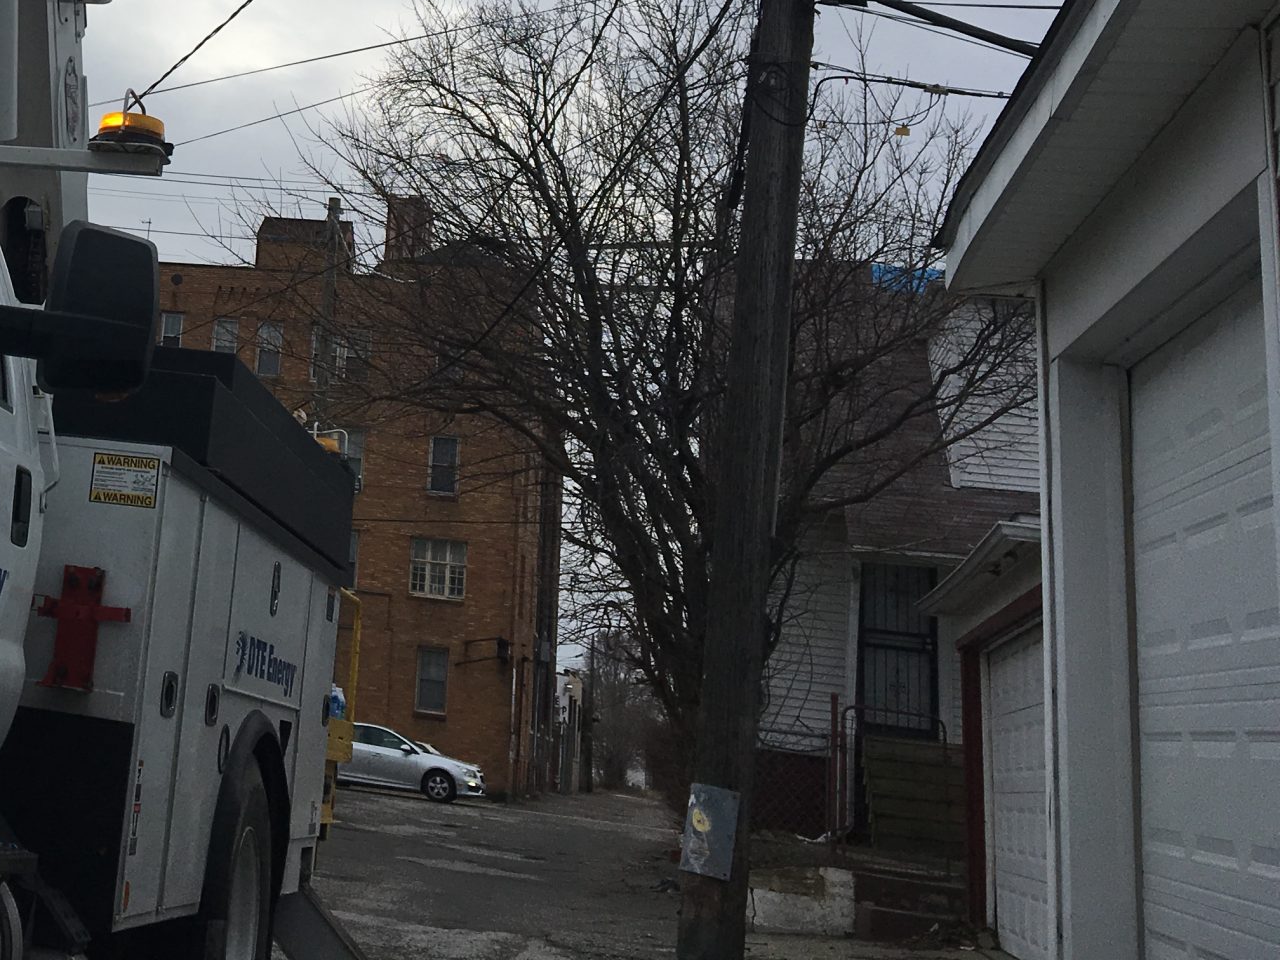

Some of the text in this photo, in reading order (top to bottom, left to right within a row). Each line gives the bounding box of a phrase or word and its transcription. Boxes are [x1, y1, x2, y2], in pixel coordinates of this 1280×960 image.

[106, 456, 156, 470] WARNING
[102, 491, 152, 506] WARNING
[247, 636, 298, 698] DTE Energy
